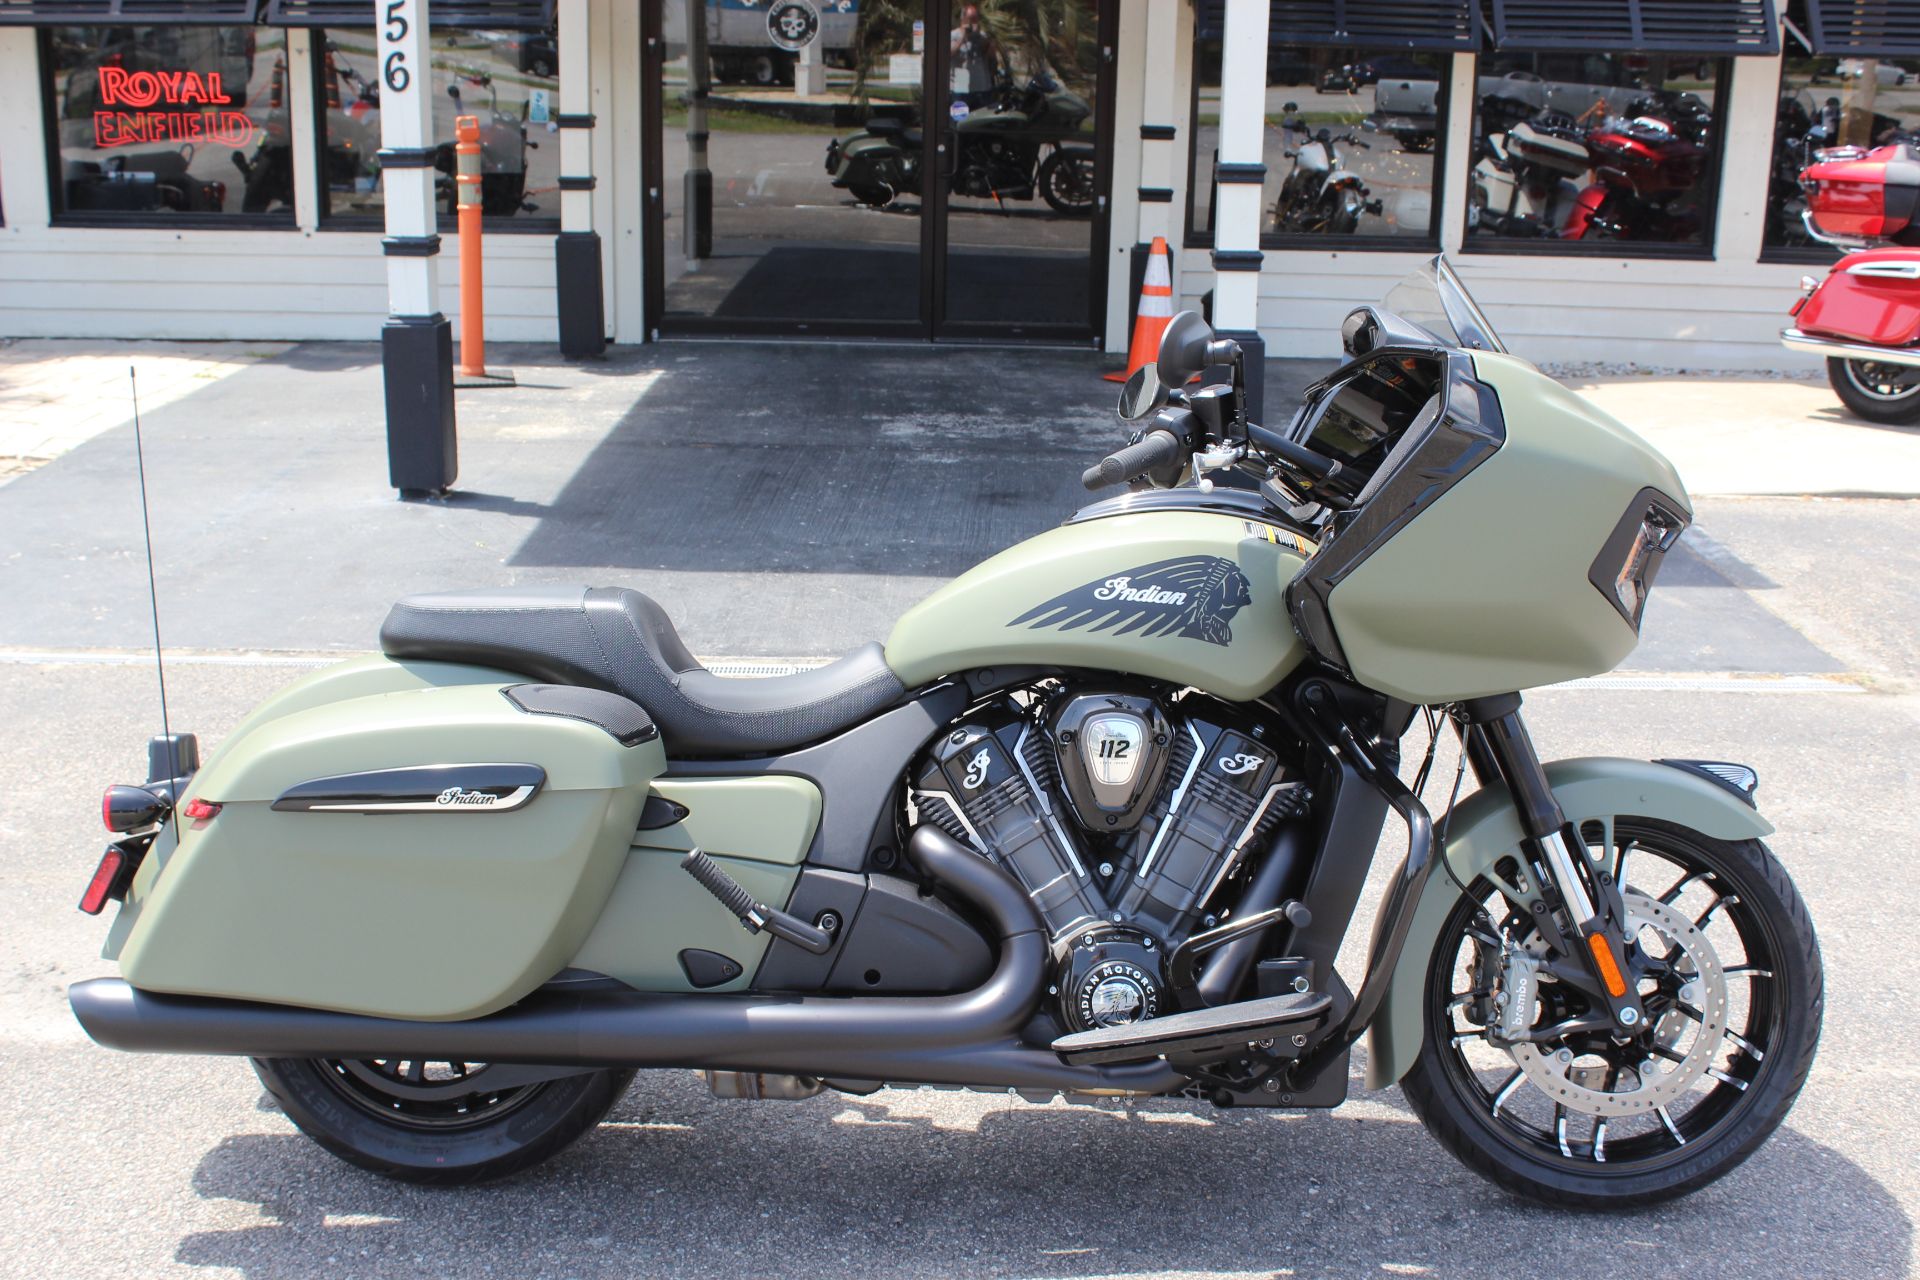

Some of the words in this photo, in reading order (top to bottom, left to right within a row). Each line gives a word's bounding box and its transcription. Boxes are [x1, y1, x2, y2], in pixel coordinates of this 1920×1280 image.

[98, 66, 232, 108] ROYAL
[93, 111, 253, 148] ENFIELD
[1093, 576, 1188, 606] Indian
[1099, 740, 1130, 758] 112
[436, 787, 497, 805] Indian
[1081, 974, 1100, 1026] INDIAN
[1102, 965, 1157, 1020] MOTORCYCL
[1511, 978, 1528, 1026] brembo
